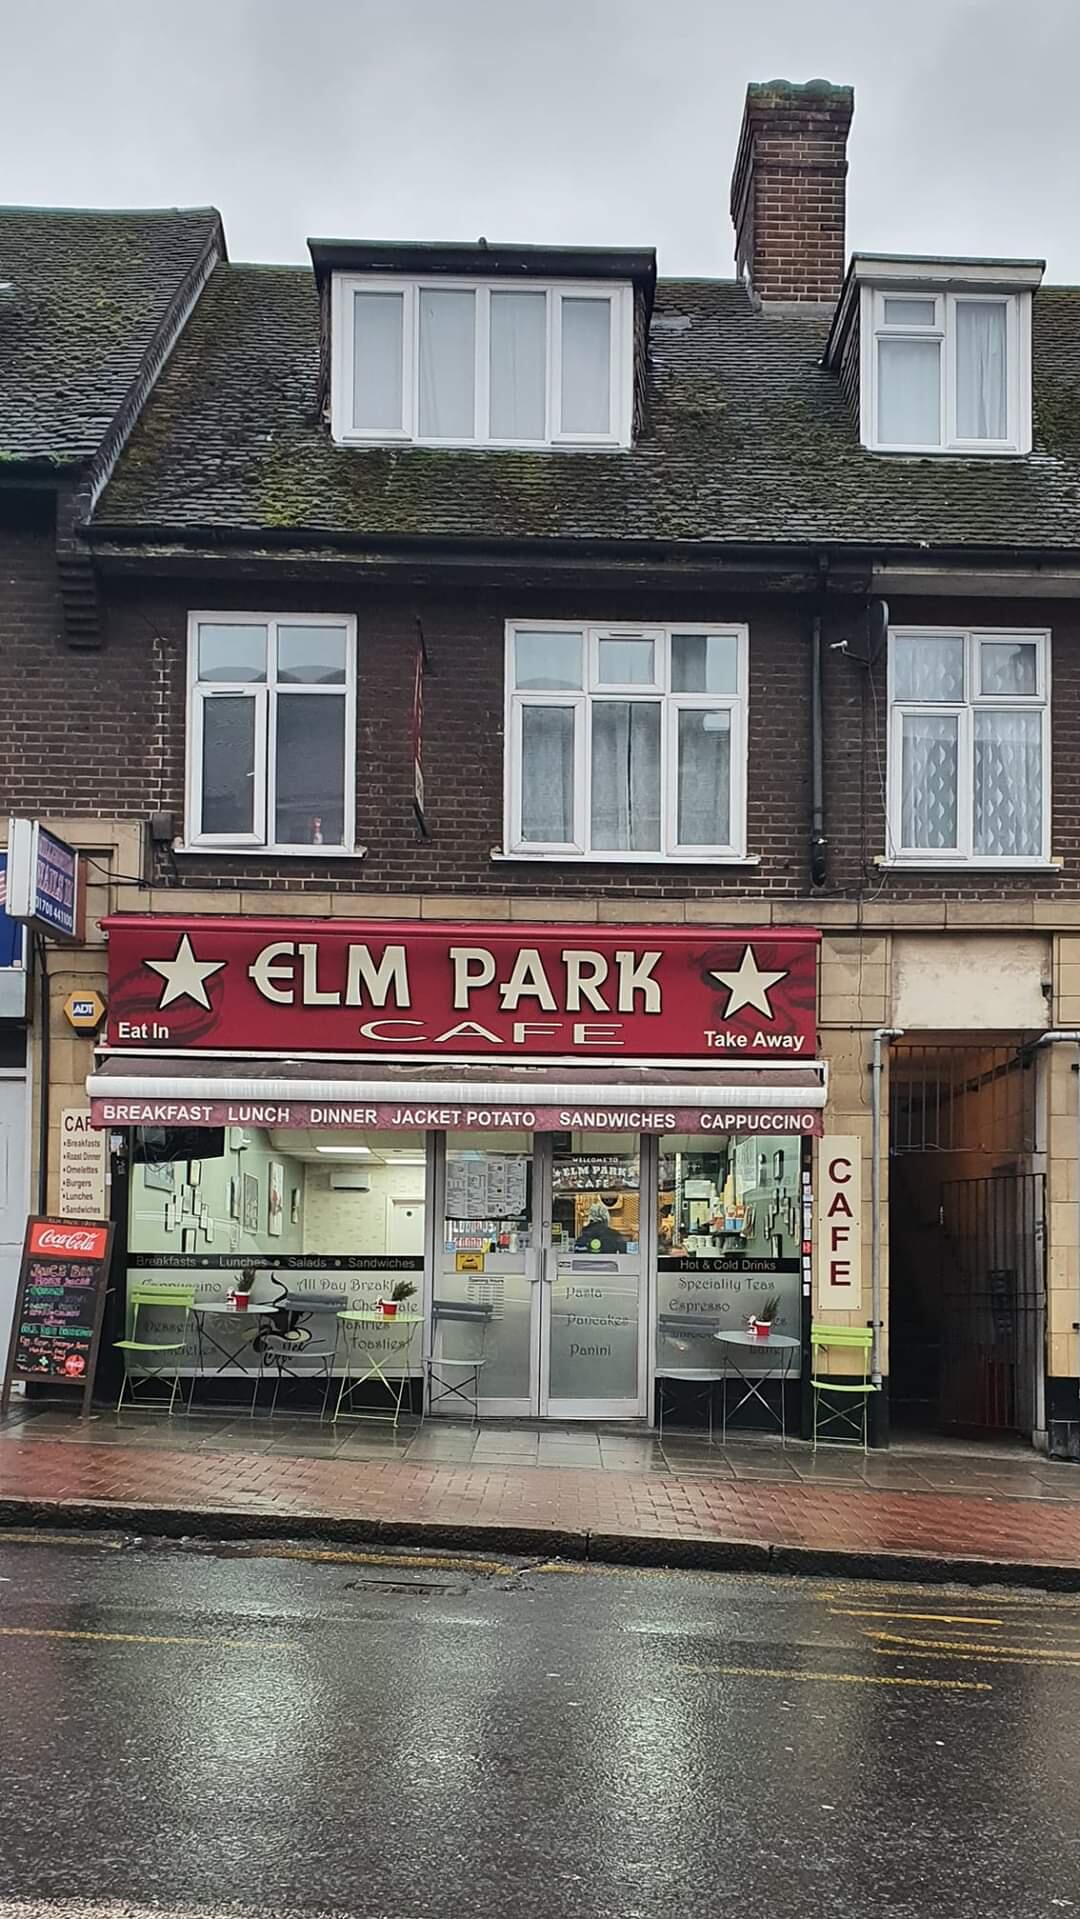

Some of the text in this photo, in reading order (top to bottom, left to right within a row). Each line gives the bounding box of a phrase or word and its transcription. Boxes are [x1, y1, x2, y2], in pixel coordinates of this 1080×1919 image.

[249, 942, 663, 1013] ELM PARK
[73, 1004, 94, 1015] ADT
[118, 1022, 169, 1039] Eat In
[360, 1020, 625, 1045] CAFE
[703, 1030, 805, 1052] Take Away
[103, 1105, 815, 1130] BREAKFAST LUNCH DINNER JACKET POTATO SANDWICHES CAPPUCCINO
[66, 1138, 101, 1148] Breakfasts
[66, 1165, 98, 1174] Omelettes
[562, 1165, 626, 1177] ELM PARK
[66, 1178, 92, 1189] Burgers
[576, 1179, 610, 1189] CAFE
[66, 1192, 93, 1201] Lunches
[66, 1205, 101, 1214] Sandwiches
[136, 1255, 267, 1268] Breakfasts Lunches
[288, 1257, 416, 1269] Salads Sandwiches
[680, 1259, 776, 1271] Hot & Cold Drinks
[297, 1278, 316, 1292] All
[320, 1278, 347, 1293] Day
[678, 1277, 775, 1292] Speciality Teas
[565, 1286, 603, 1300] Pasta
[351, 1299, 418, 1313] Choate
[669, 1299, 731, 1313] Espresso
[566, 1312, 630, 1327] Pancakes
[569, 1343, 612, 1357] Panini
